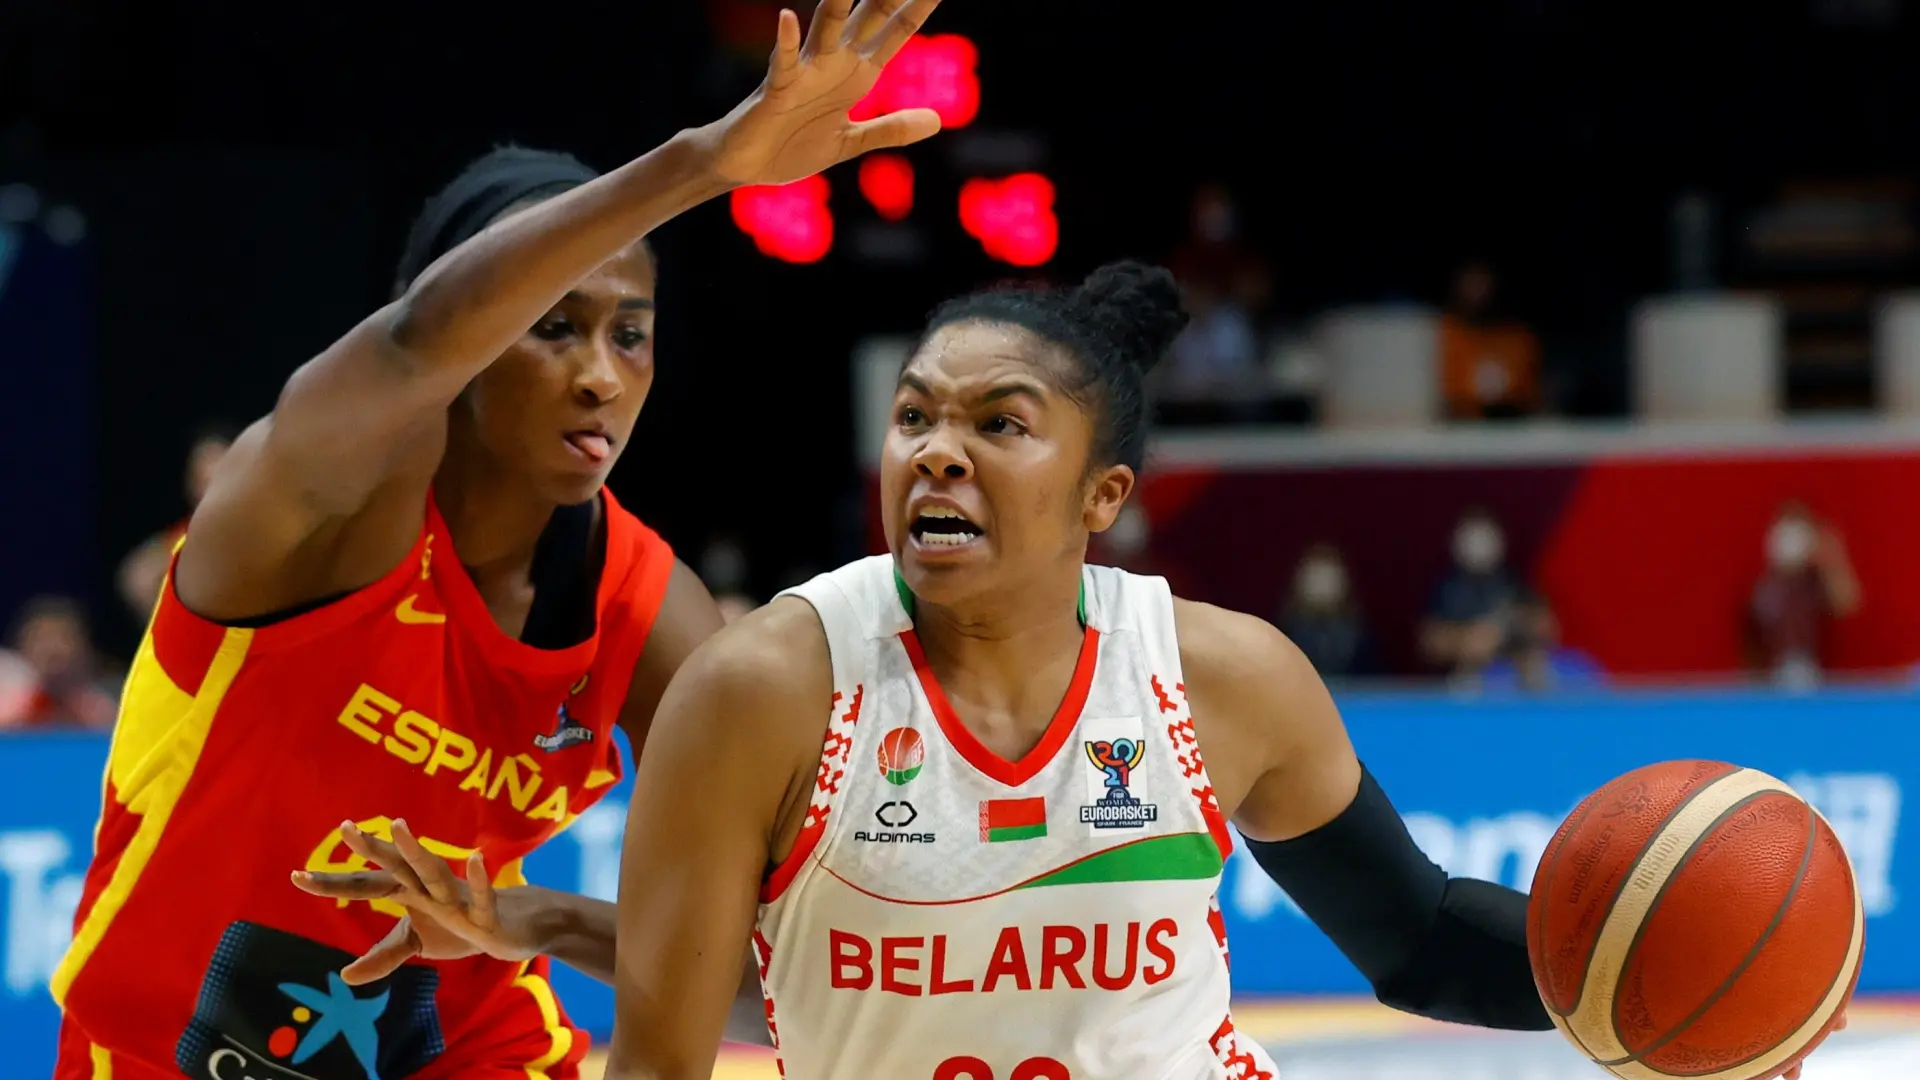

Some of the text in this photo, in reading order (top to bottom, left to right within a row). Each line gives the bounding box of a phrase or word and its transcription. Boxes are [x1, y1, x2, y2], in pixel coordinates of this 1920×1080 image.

[337, 682, 568, 823] ESPAÑA
[1081, 805, 1155, 821] EUROBASKET
[854, 831, 936, 844] AUDIMAS
[829, 918, 1178, 997] BELARUS
